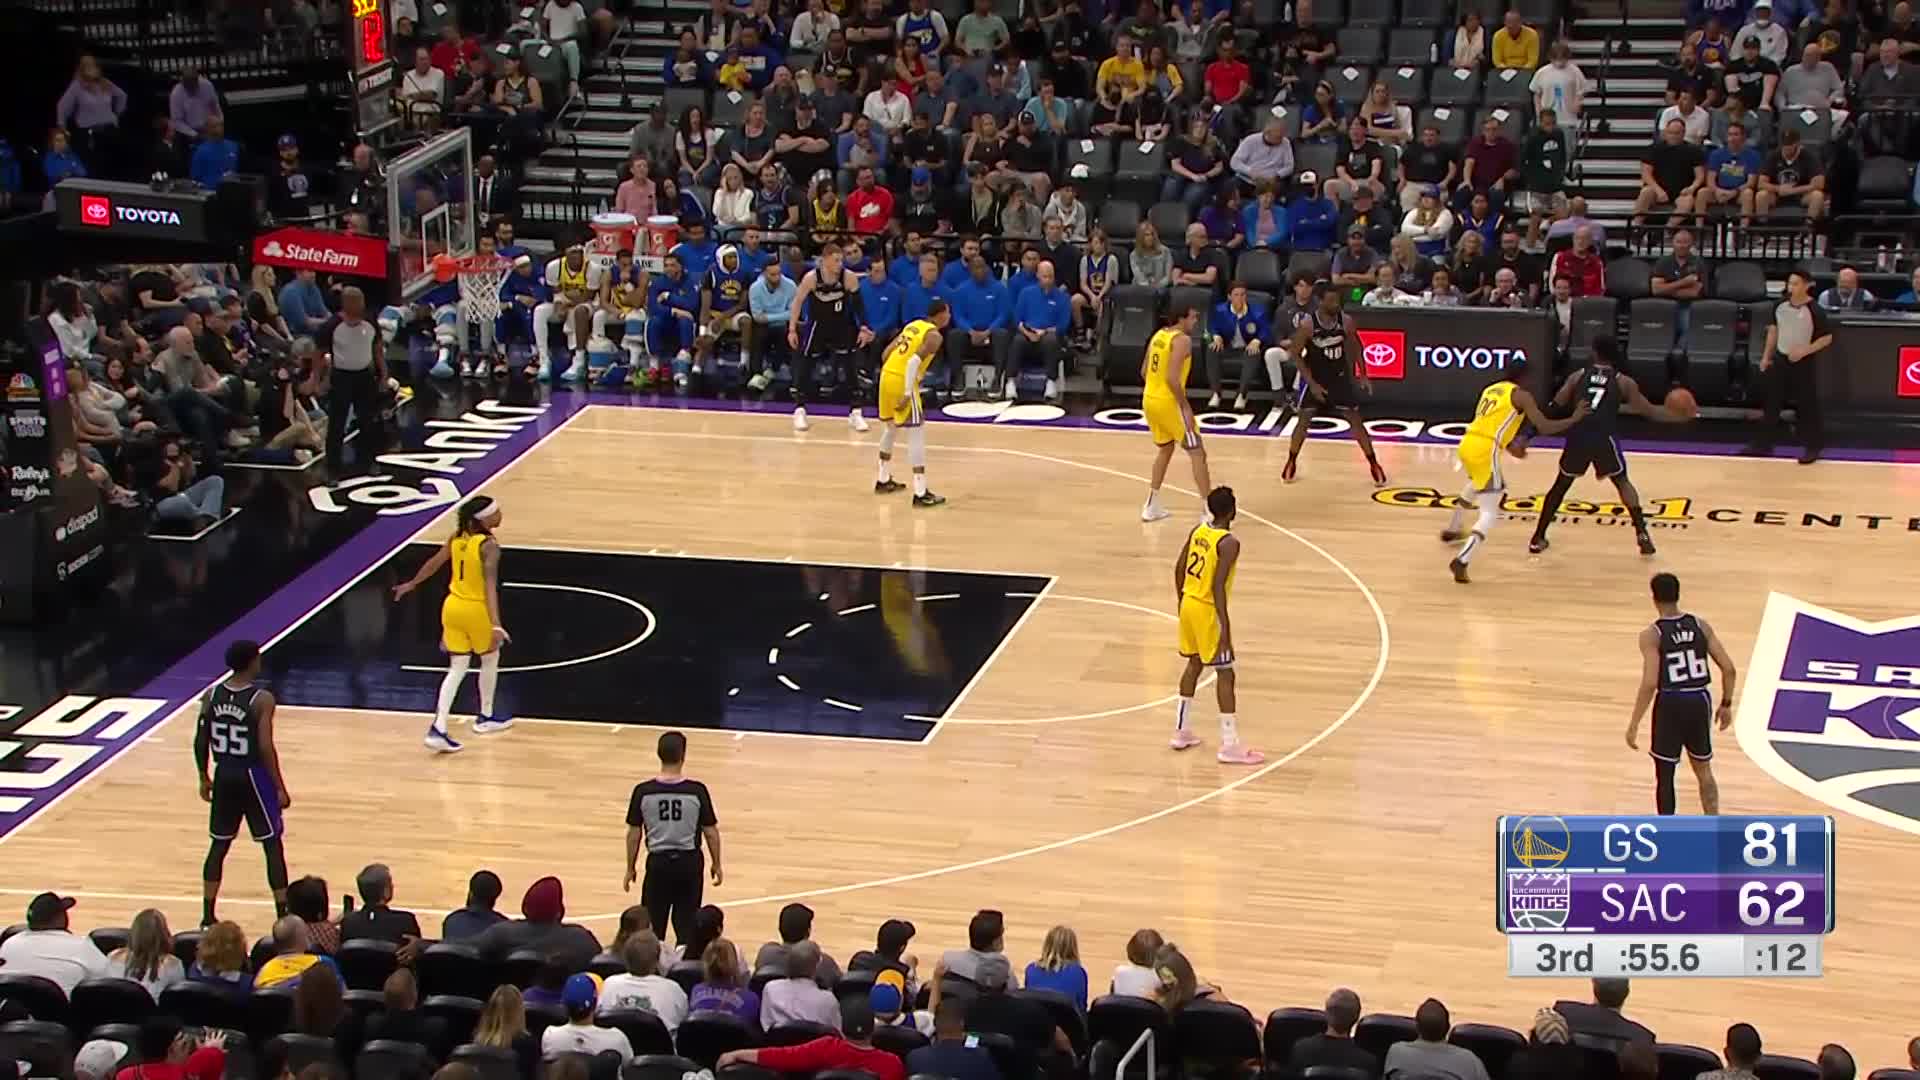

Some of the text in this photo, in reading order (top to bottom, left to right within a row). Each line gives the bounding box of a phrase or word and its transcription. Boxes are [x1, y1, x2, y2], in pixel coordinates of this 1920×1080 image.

[115, 206, 181, 225] TOYOTA
[1588, 388, 1605, 410] 7
[459, 560, 464, 581] 1
[1187, 552, 1205, 580] 22
[1666, 649, 1708, 682] 26
[211, 721, 249, 755] 55
[659, 799, 682, 821] 26
